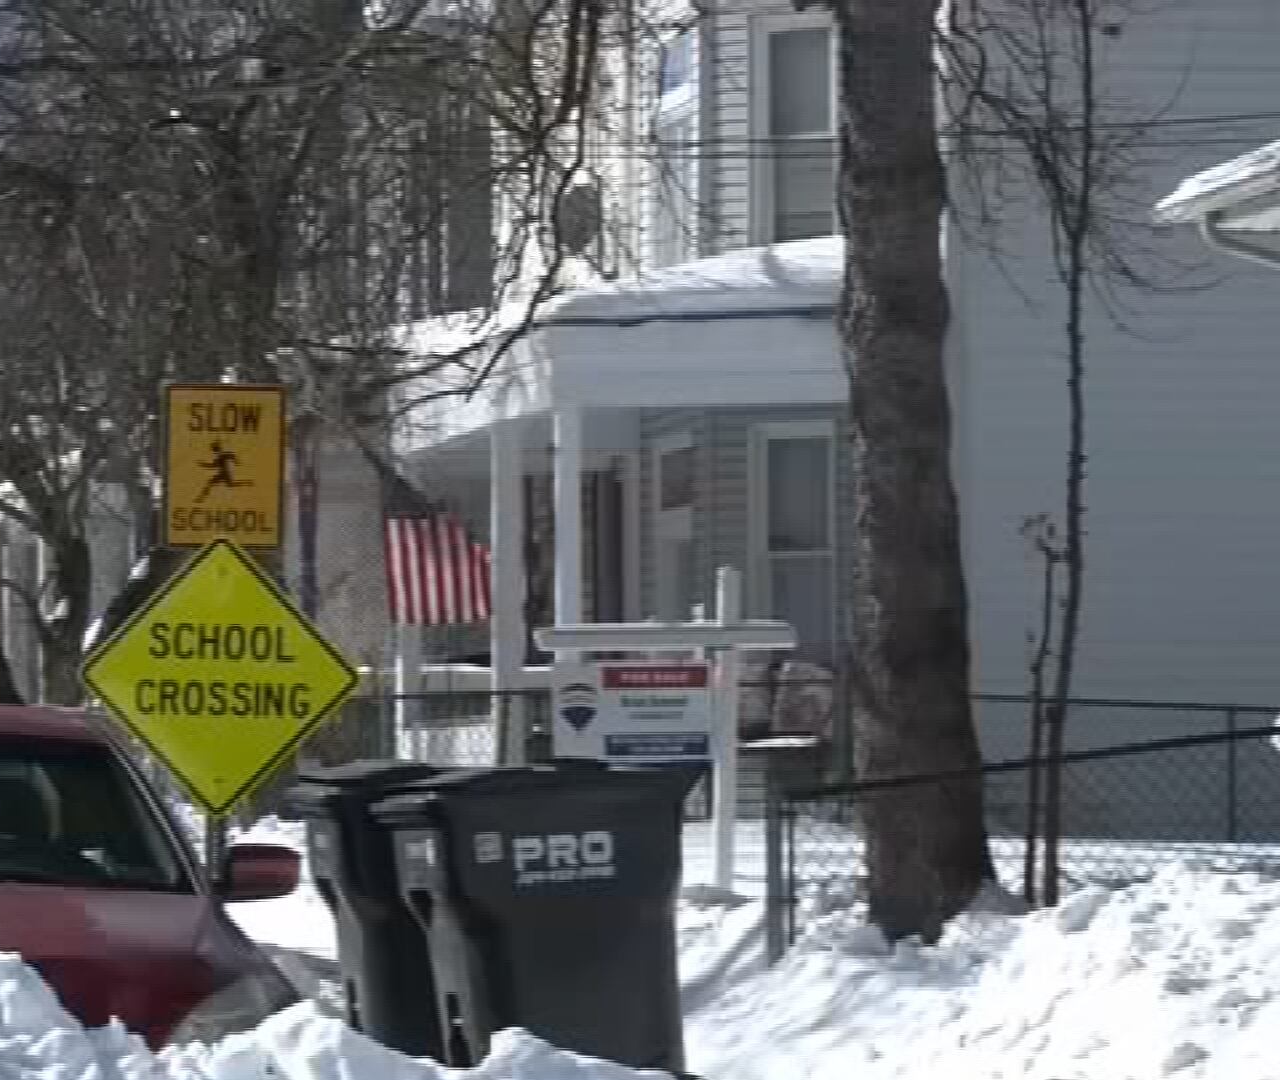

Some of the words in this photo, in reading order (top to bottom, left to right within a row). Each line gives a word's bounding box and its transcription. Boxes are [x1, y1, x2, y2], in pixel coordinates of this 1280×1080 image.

[189, 403, 259, 433] SLOW
[171, 507, 273, 532] SCHOOL
[149, 623, 296, 663] SCHOOL
[135, 679, 310, 719] CROSSING
[512, 831, 614, 871] PRO
